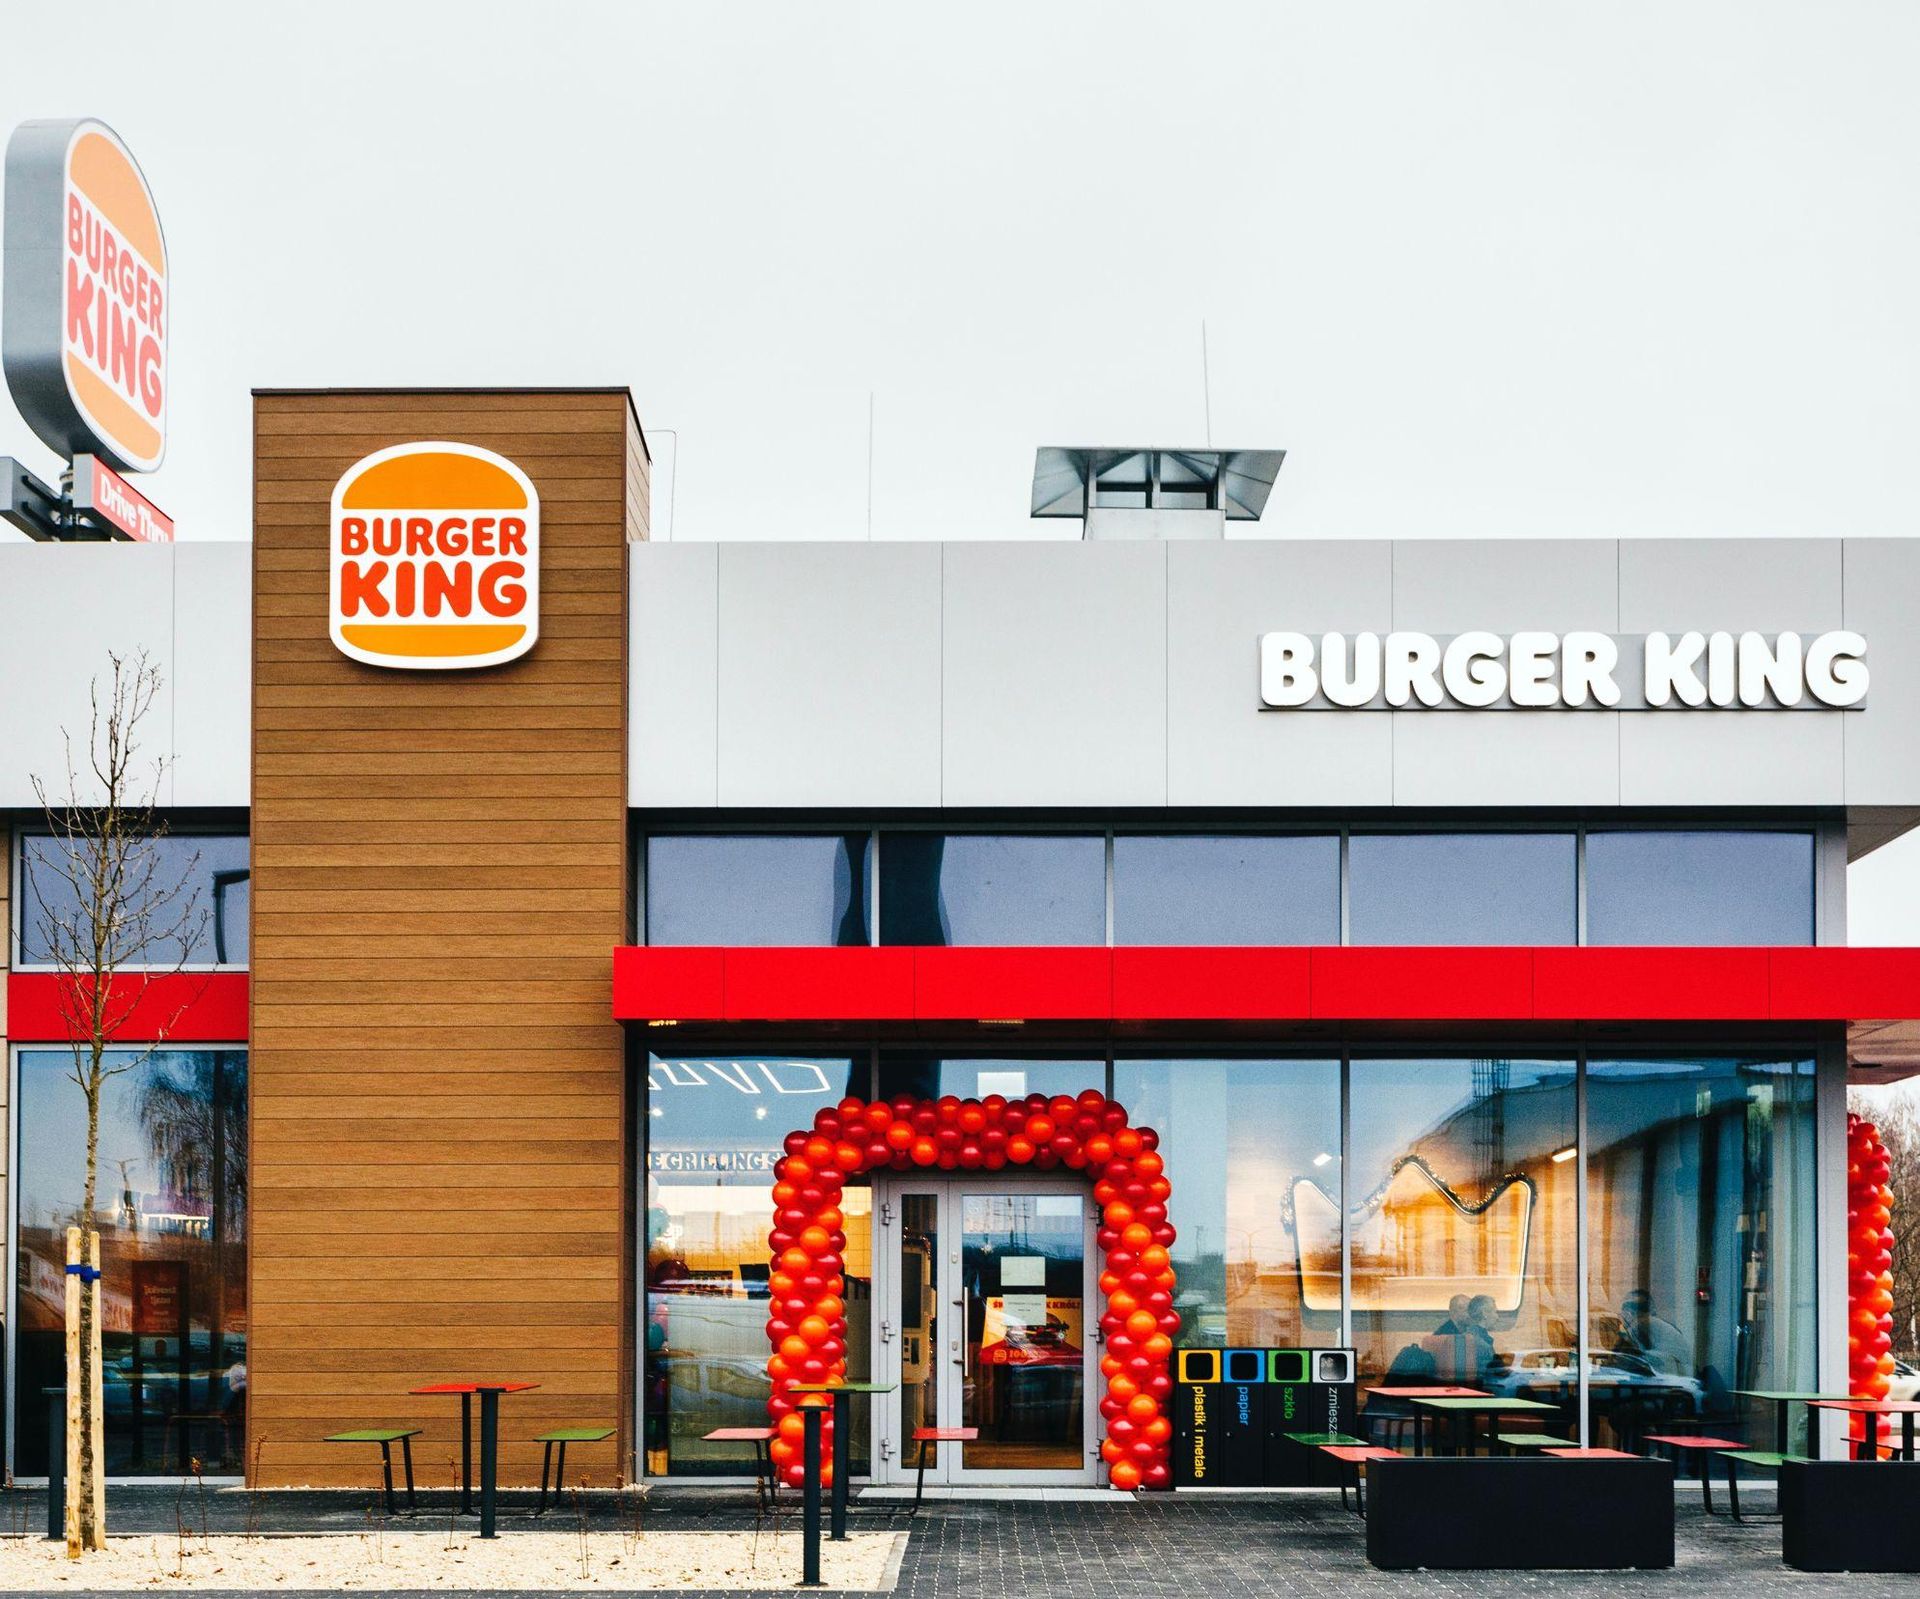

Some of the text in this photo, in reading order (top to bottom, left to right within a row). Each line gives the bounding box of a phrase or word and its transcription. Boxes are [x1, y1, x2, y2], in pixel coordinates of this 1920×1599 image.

[67, 191, 164, 341] BURGER
[67, 257, 163, 419] KING
[100, 472, 137, 529] Drive
[341, 517, 528, 557] BURGER
[340, 560, 528, 618] KING
[1260, 631, 1870, 708] BURGER KING
[1192, 1386, 1206, 1426] plastik
[1236, 1386, 1250, 1426] papier
[1195, 1436, 1206, 1478] metale
